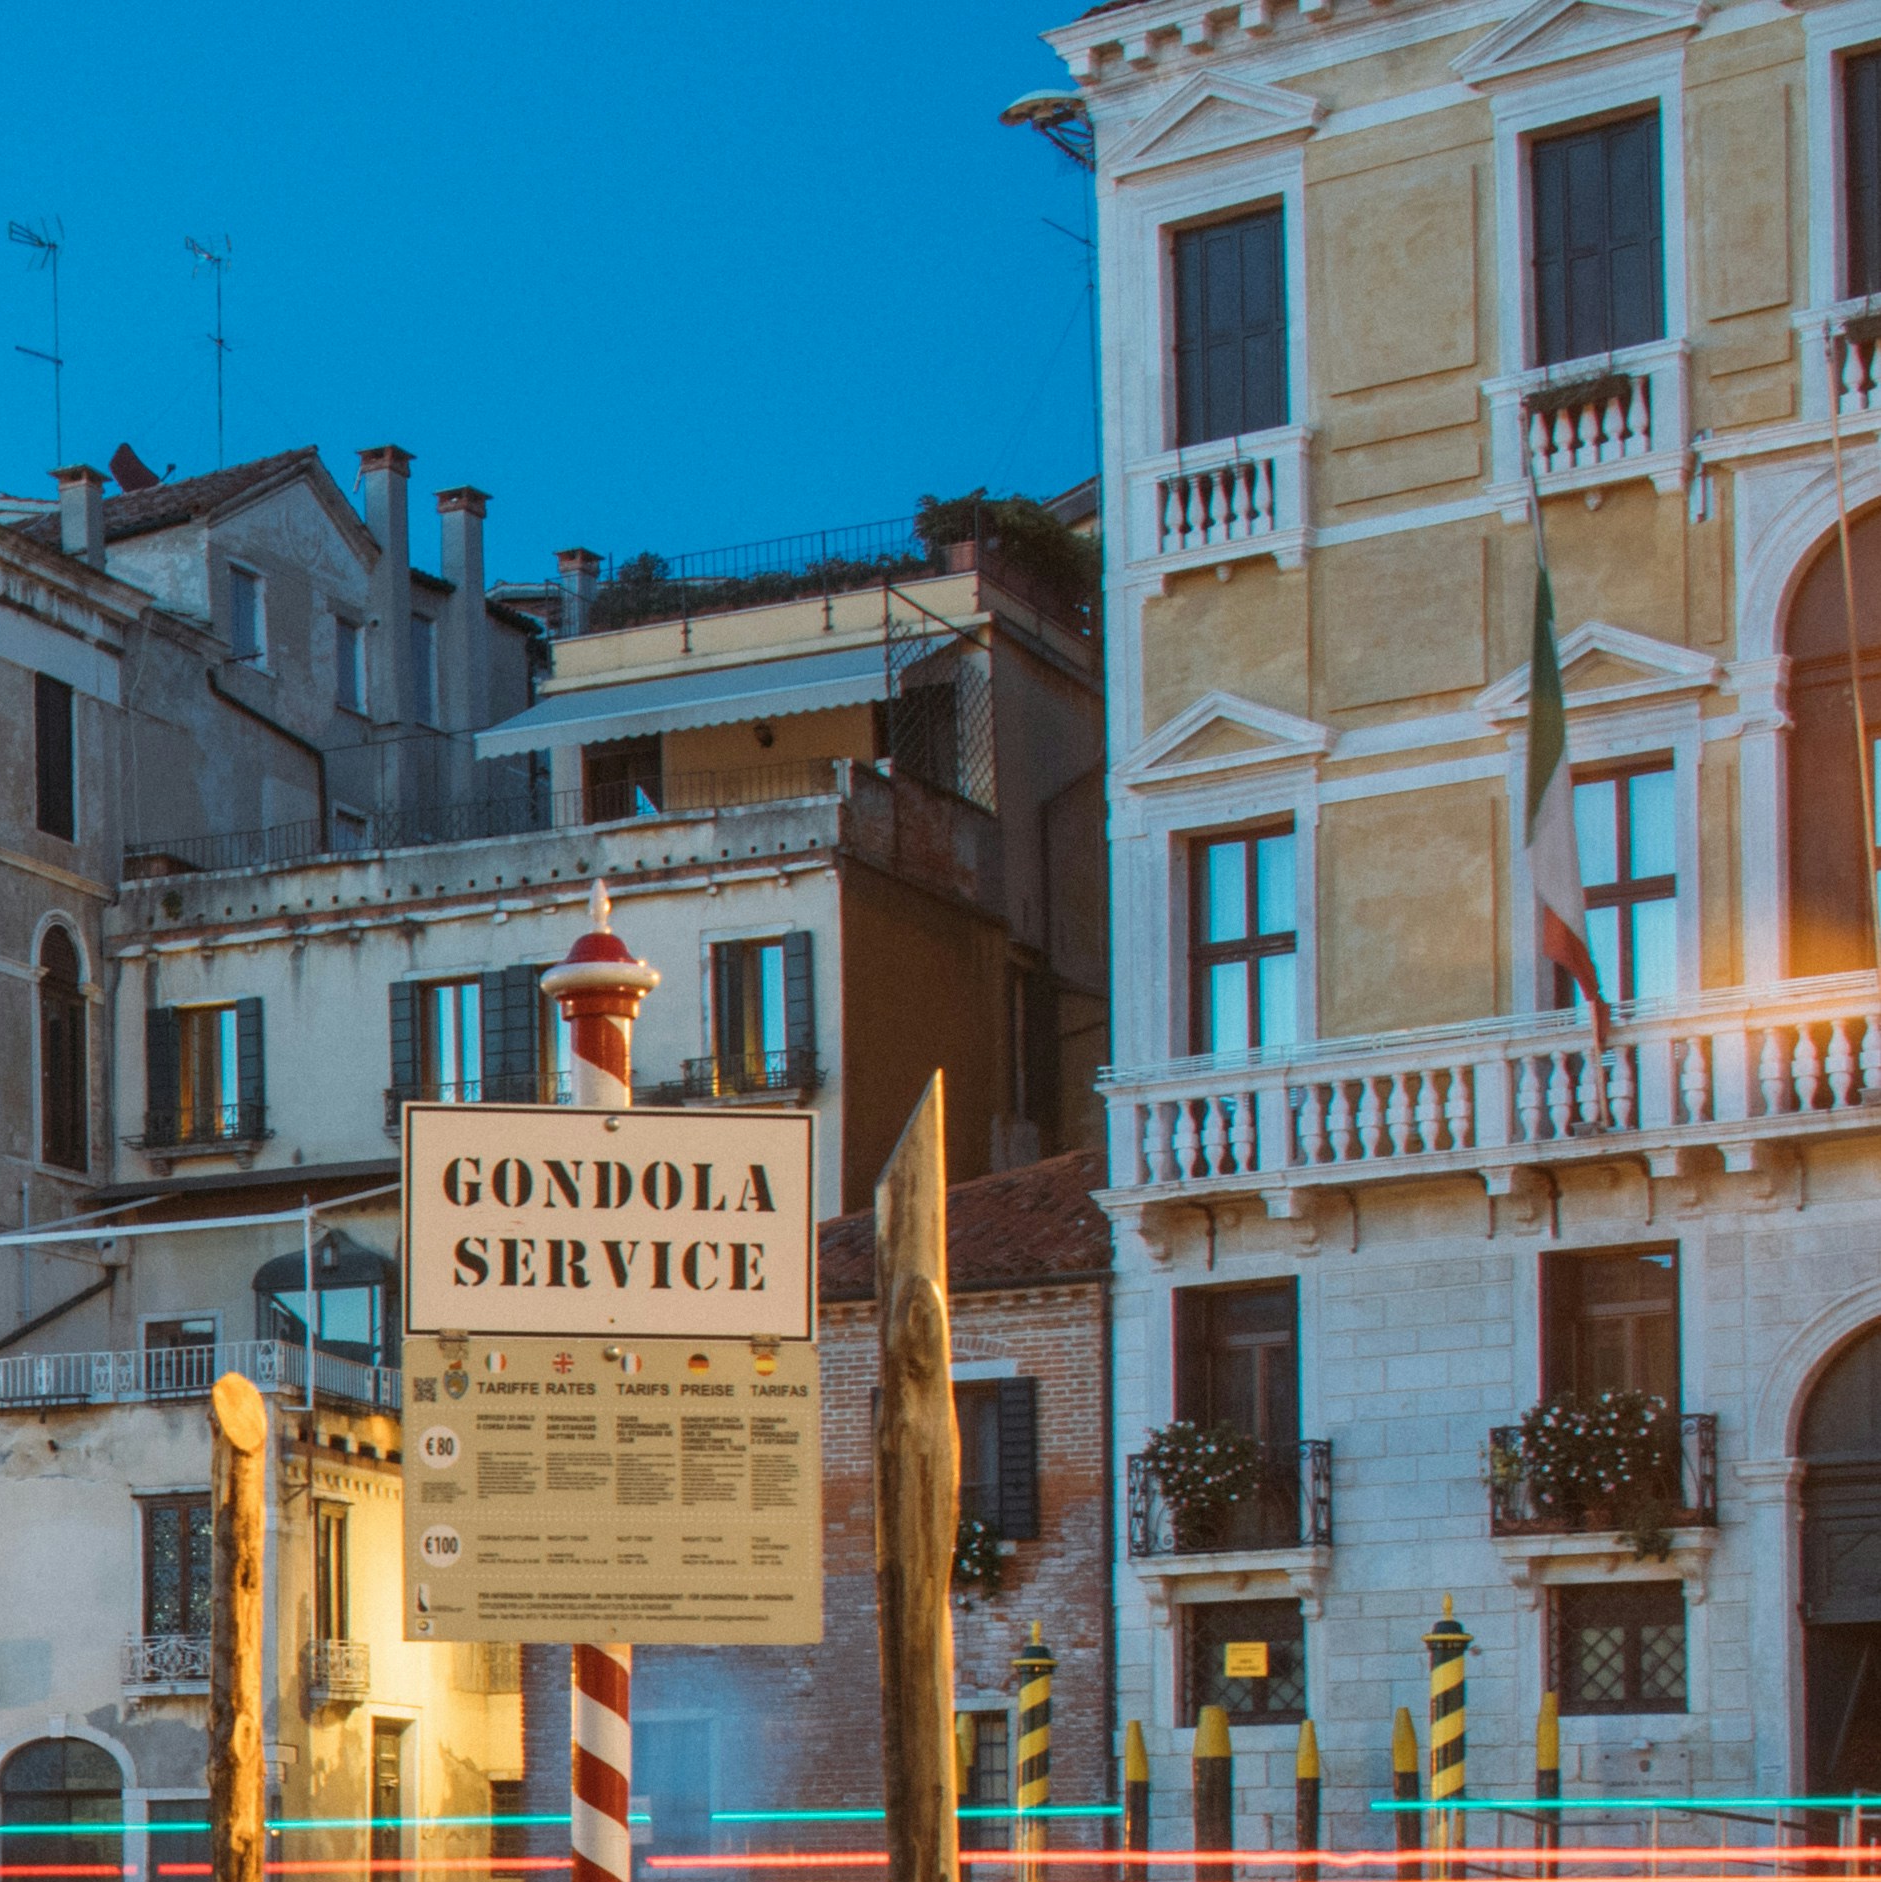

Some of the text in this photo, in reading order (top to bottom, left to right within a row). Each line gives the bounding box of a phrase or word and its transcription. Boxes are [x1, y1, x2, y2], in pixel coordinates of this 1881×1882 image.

[441, 1156, 777, 1213] GONDOLA
[453, 1235, 767, 1291] SERVICE
[476, 1381, 540, 1397] TARIFFE
[545, 1382, 597, 1397] RATES
[615, 1382, 671, 1397] TARIFS
[680, 1383, 735, 1397] PREISE
[750, 1383, 809, 1398] TARIFAS
